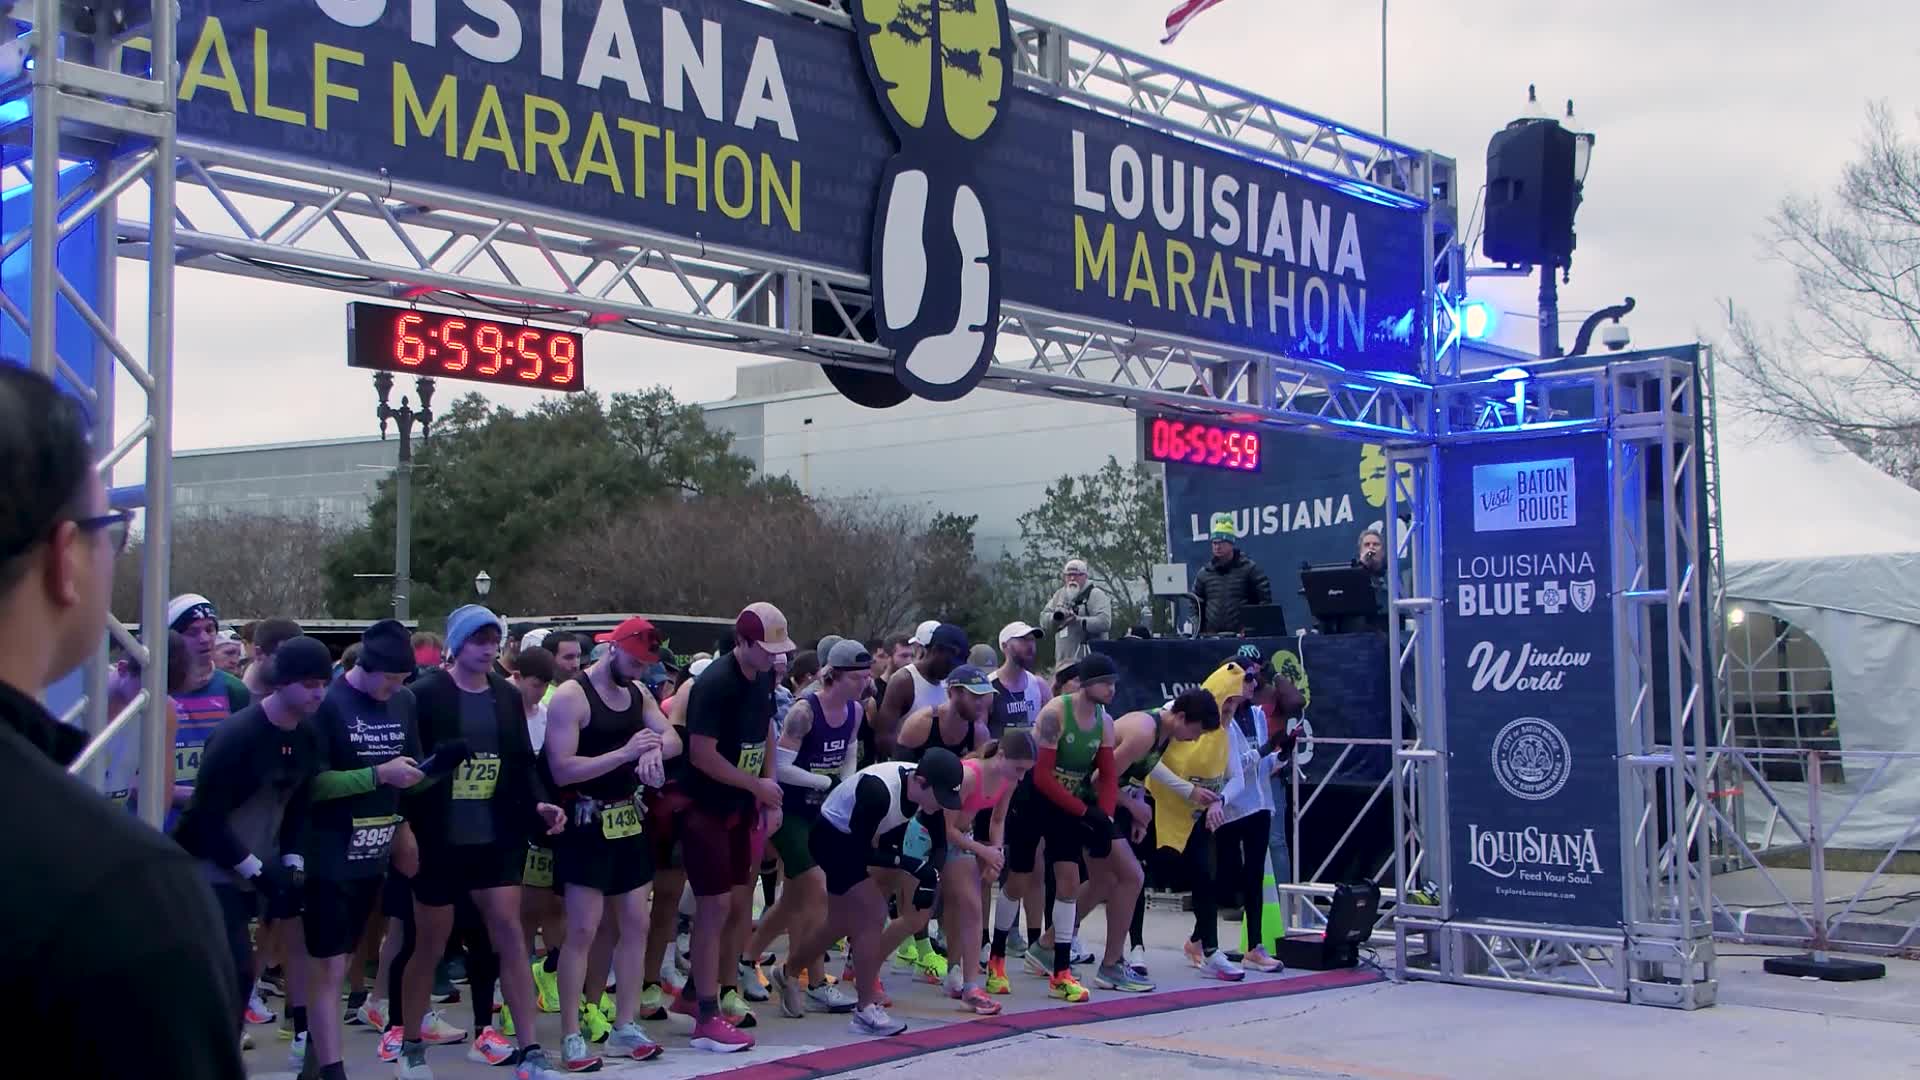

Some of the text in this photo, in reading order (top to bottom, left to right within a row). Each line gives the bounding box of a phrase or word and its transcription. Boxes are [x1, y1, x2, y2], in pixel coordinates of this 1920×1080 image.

[120, 16, 365, 131] ALF
[393, 61, 801, 232] MARATHON
[1072, 129, 1366, 281] LOUISIANA
[1074, 214, 1366, 352] MARATHON
[397, 314, 576, 385] 6:59:59
[1153, 419, 1257, 469] 06:59:59
[1517, 467, 1568, 496] BATON
[1481, 486, 1513, 512] Visit
[1518, 495, 1568, 522] ROUGE
[1458, 552, 1595, 578] LOUISIANA
[1458, 583, 1530, 616] BLUE
[824, 740, 845, 752] LSU
[1468, 824, 1604, 878] LOUISIANA
[1519, 870, 1592, 884] Feed Your Soul.
